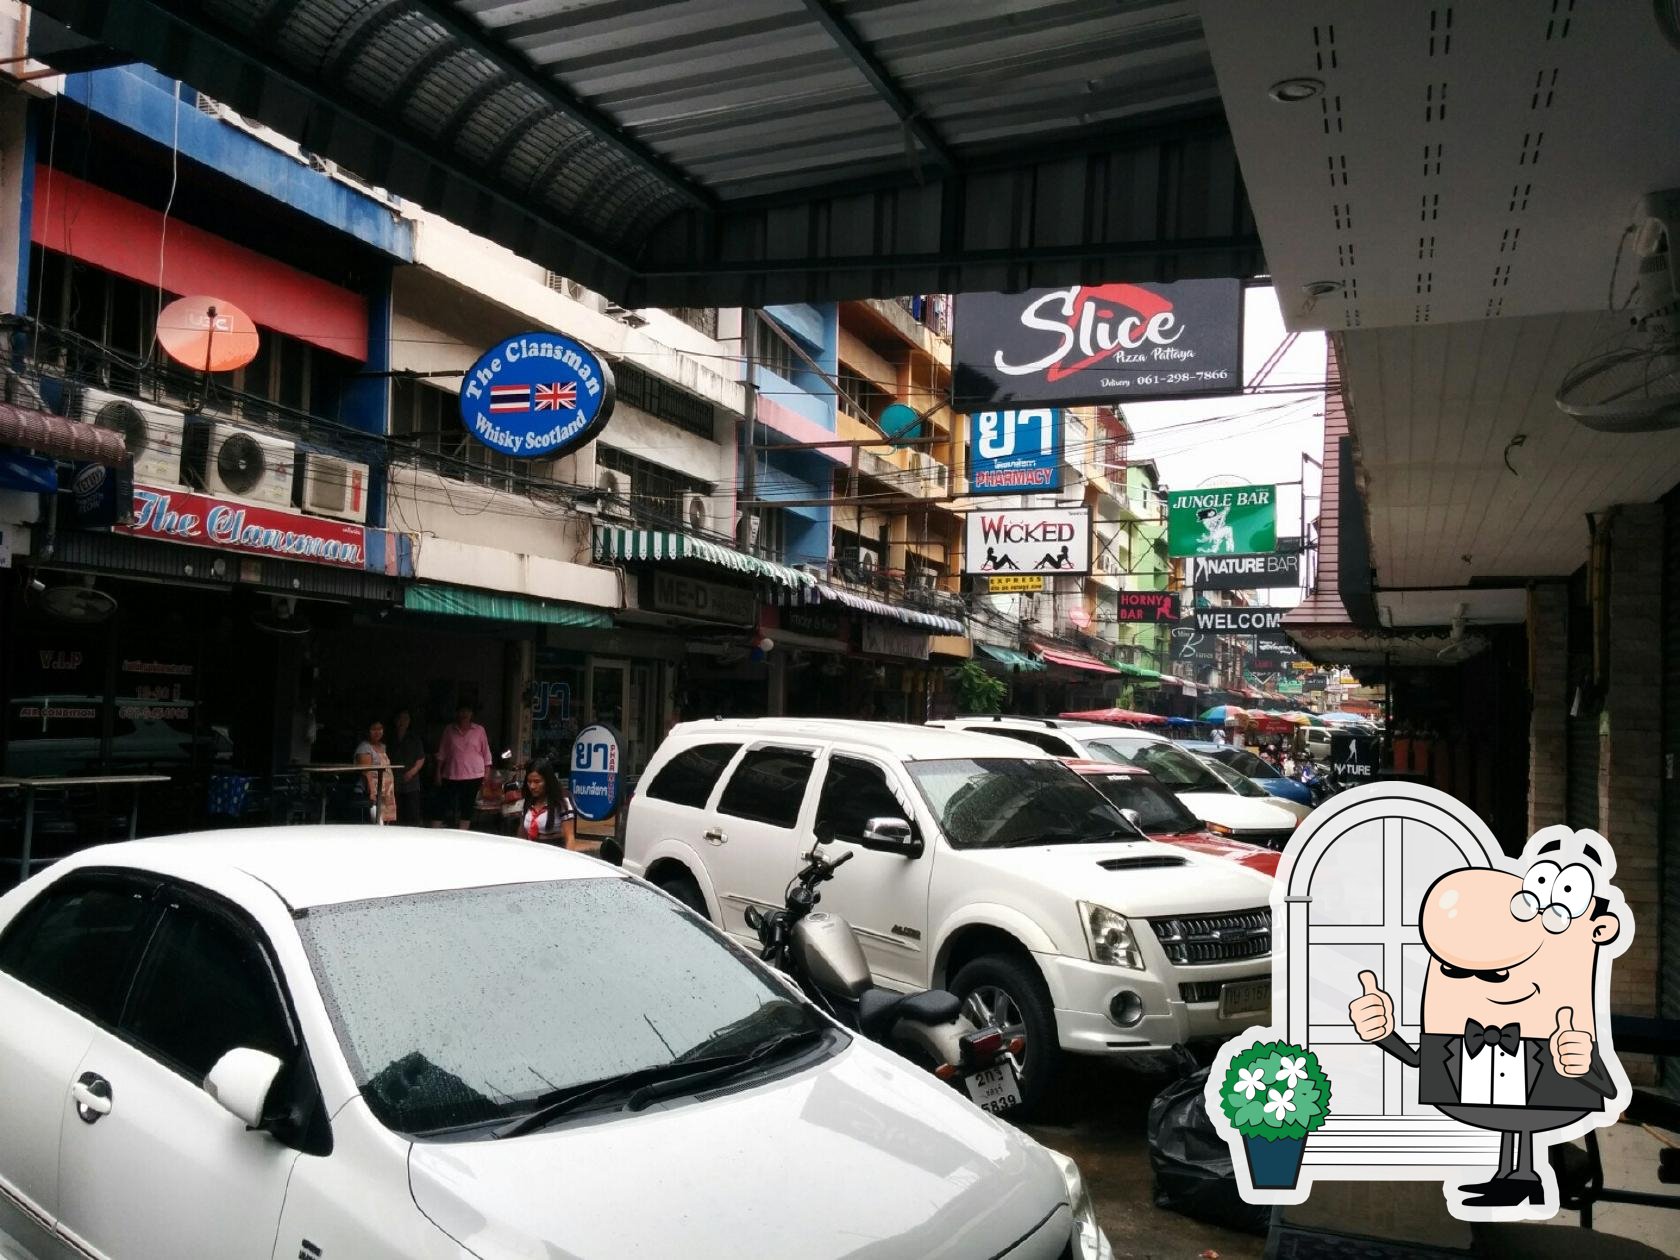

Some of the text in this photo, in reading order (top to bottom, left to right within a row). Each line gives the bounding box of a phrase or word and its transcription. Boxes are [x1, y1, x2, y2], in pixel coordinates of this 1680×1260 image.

[994, 285, 1185, 376] Slice
[1115, 347, 1196, 364] Pizza Pattaya
[466, 339, 600, 400] The Clansman
[1137, 369, 1228, 386] 061-298-7866
[475, 408, 587, 453] Whisky Scotland
[979, 408, 1053, 458] ยา
[976, 468, 1053, 488] PHARMACY
[1173, 492, 1270, 509] JUNGLE BAR
[128, 489, 365, 564] The Clansman
[981, 515, 1075, 544] WICKED
[1208, 556, 1298, 574] NATURE BAR
[1121, 594, 1163, 606] HORNY
[1121, 608, 1143, 619] BAR
[1197, 613, 1280, 629] WELCOM
[576, 743, 608, 770] ยา
